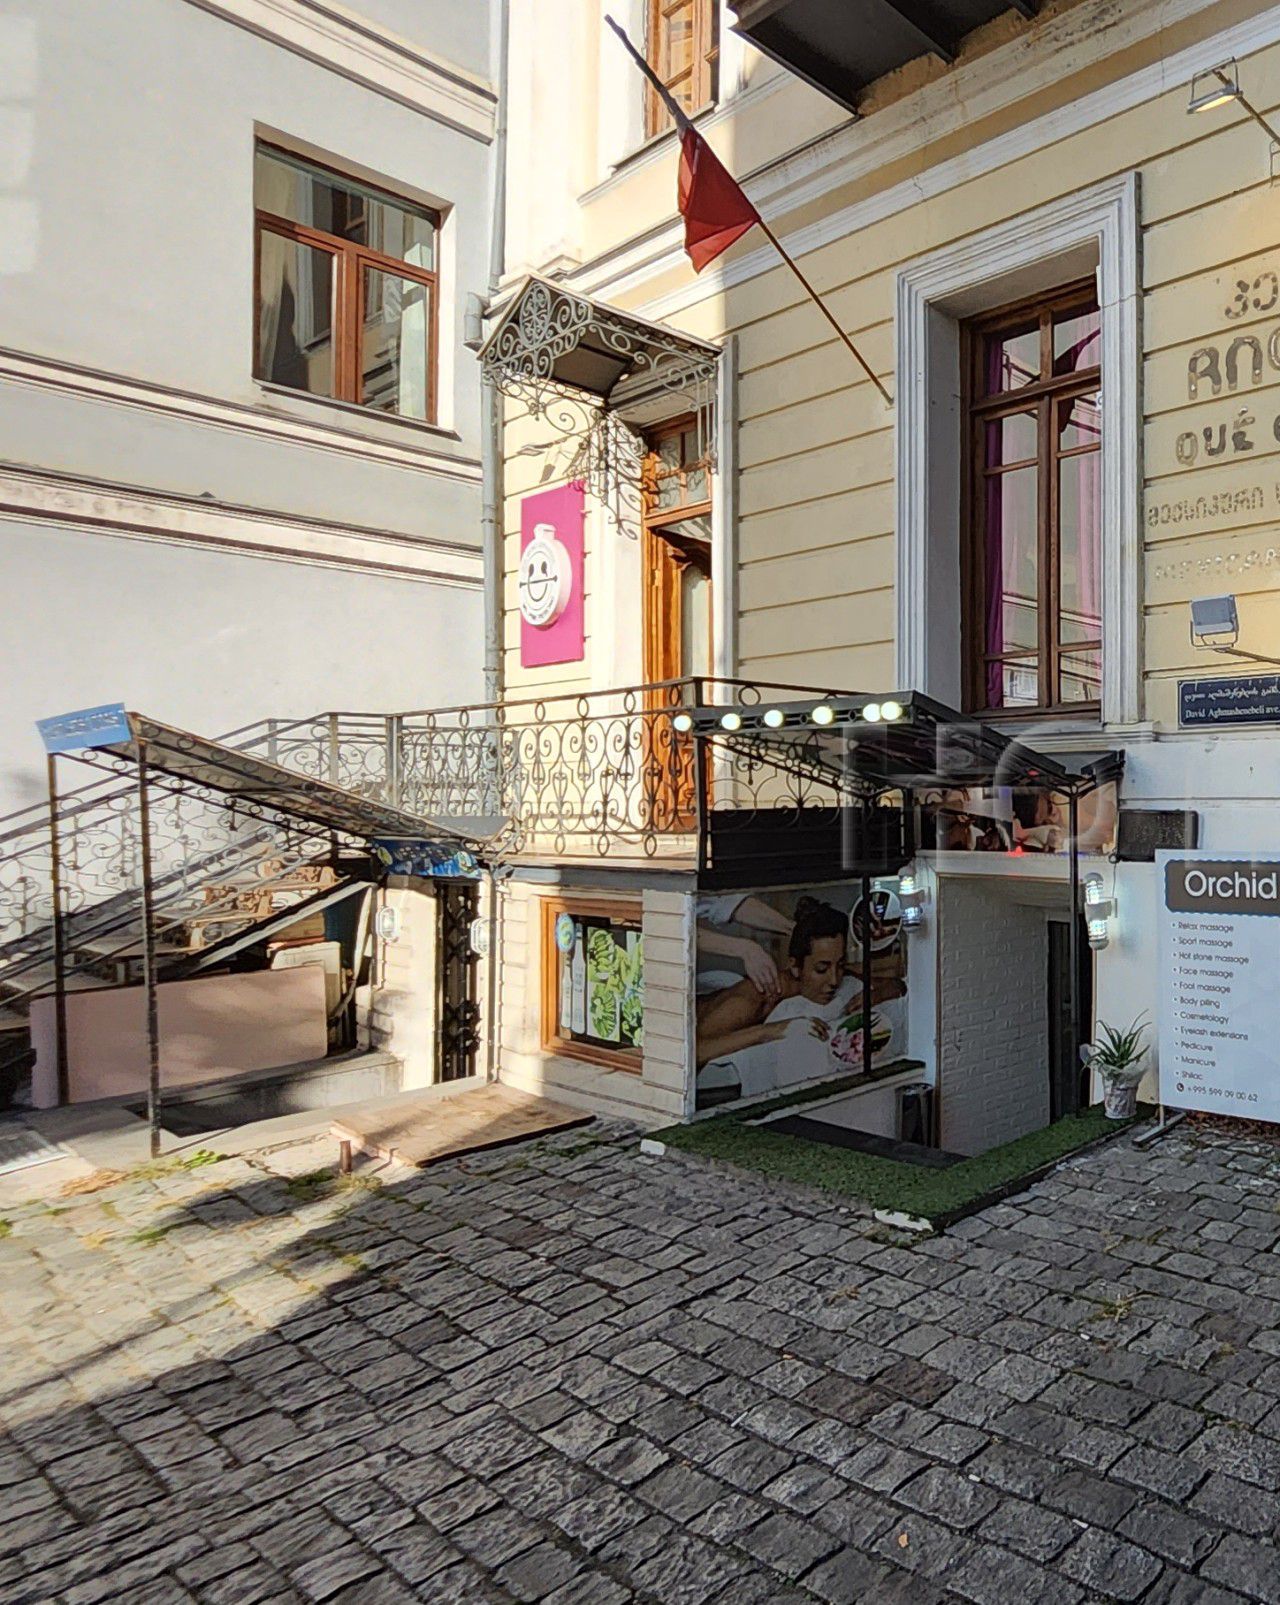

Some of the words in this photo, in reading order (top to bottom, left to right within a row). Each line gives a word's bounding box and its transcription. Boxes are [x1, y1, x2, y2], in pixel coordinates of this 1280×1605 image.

[1175, 405, 1255, 466] QUÉ
[1185, 708, 1206, 719] David
[1184, 869, 1278, 900] Orchid
[1178, 921, 1198, 930] Relax
[1200, 924, 1234, 933] massage
[1178, 937, 1197, 946] Sport
[1199, 939, 1233, 948] massage
[1179, 952, 1191, 960] Hot
[1193, 952, 1213, 961] stone
[1215, 955, 1249, 965] massage
[1179, 966, 1198, 975] Face
[1200, 969, 1234, 979] massage
[1197, 984, 1231, 994] massage
[1180, 996, 1198, 1007] Body
[1180, 1011, 1229, 1025] Cosmetology
[1180, 1026, 1208, 1036] Eyelash
[1210, 1029, 1249, 1041] extensions
[1180, 1041, 1213, 1052] Pedicure
[1181, 1055, 1216, 1067] Manicure
